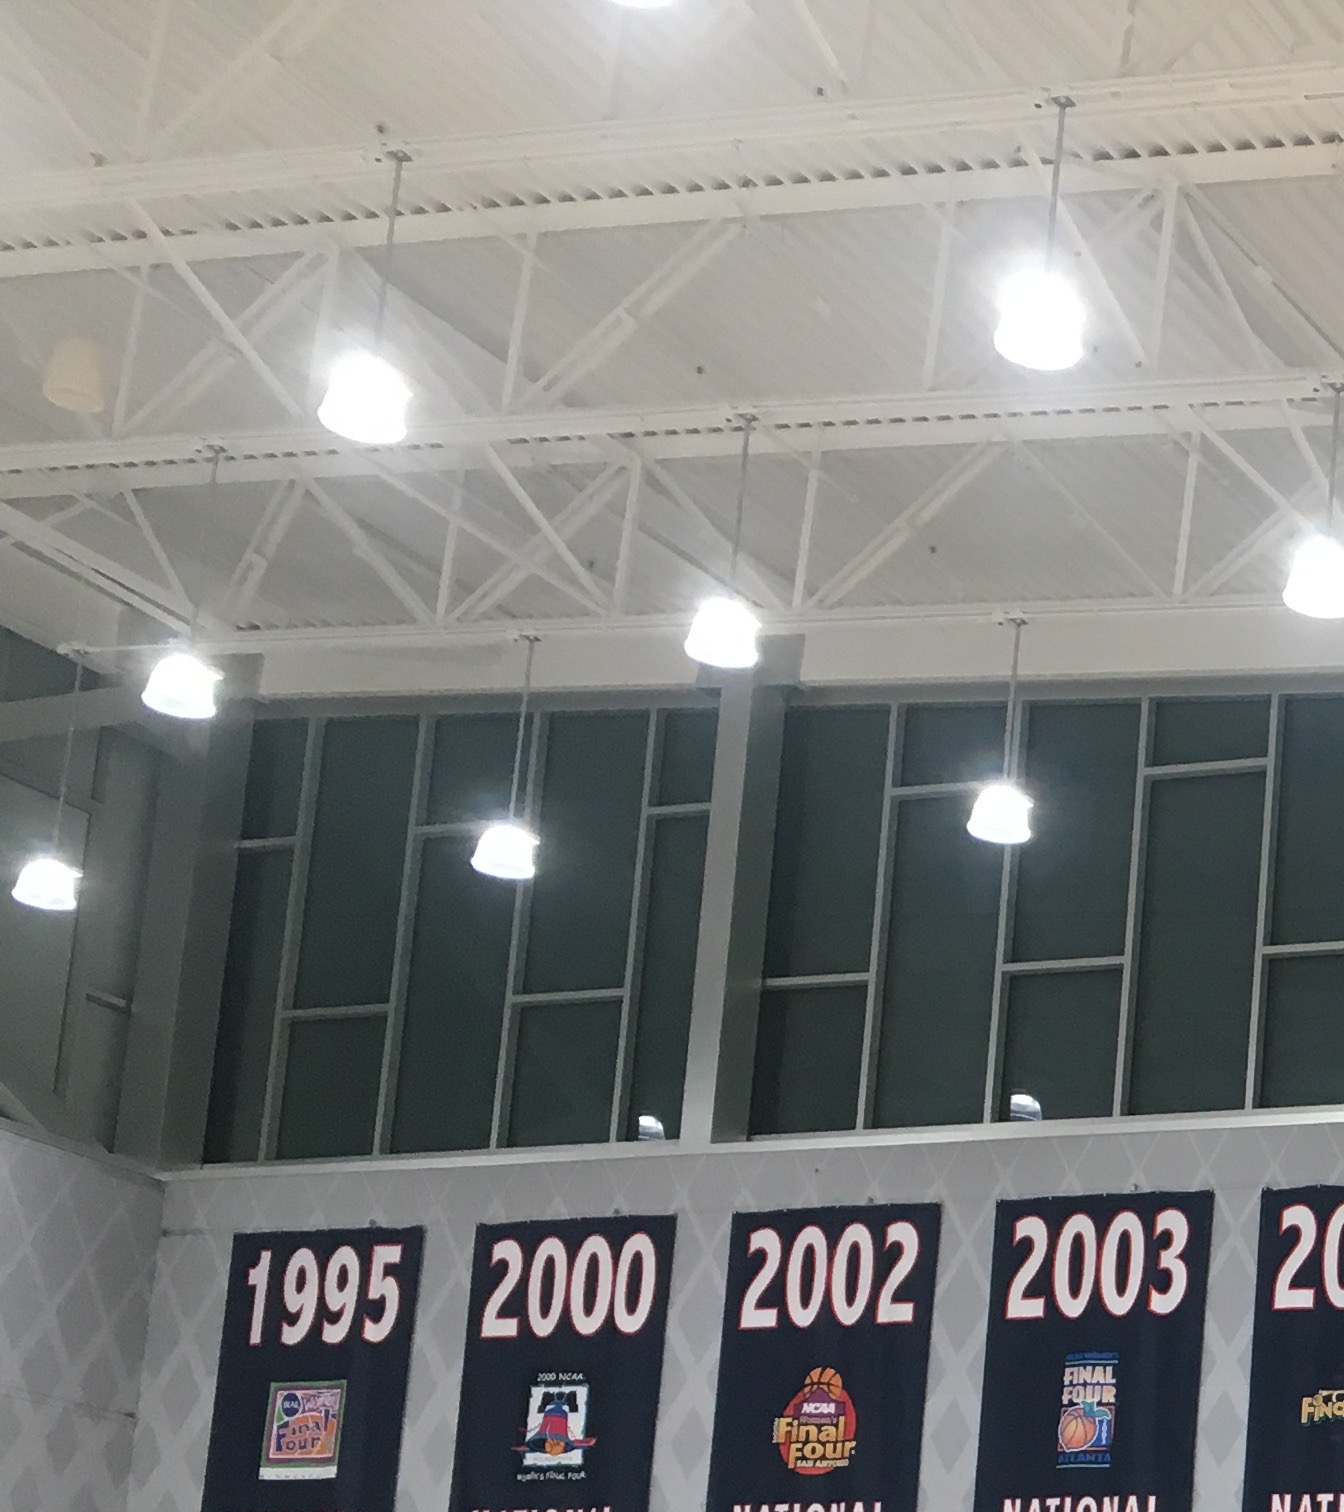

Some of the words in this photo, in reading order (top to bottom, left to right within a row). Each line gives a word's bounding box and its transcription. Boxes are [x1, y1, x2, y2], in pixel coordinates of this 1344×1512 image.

[738, 1220, 920, 1330] 2002
[1005, 1207, 1190, 1320] 2003
[247, 1244, 403, 1346] 1995
[479, 1231, 657, 1339] 2000
[1063, 1366, 1117, 1385] FINAL
[801, 1402, 836, 1414] NCAA
[1062, 1385, 1117, 1404] FOUR
[777, 1415, 846, 1443] Final
[788, 1441, 857, 1469] Four
